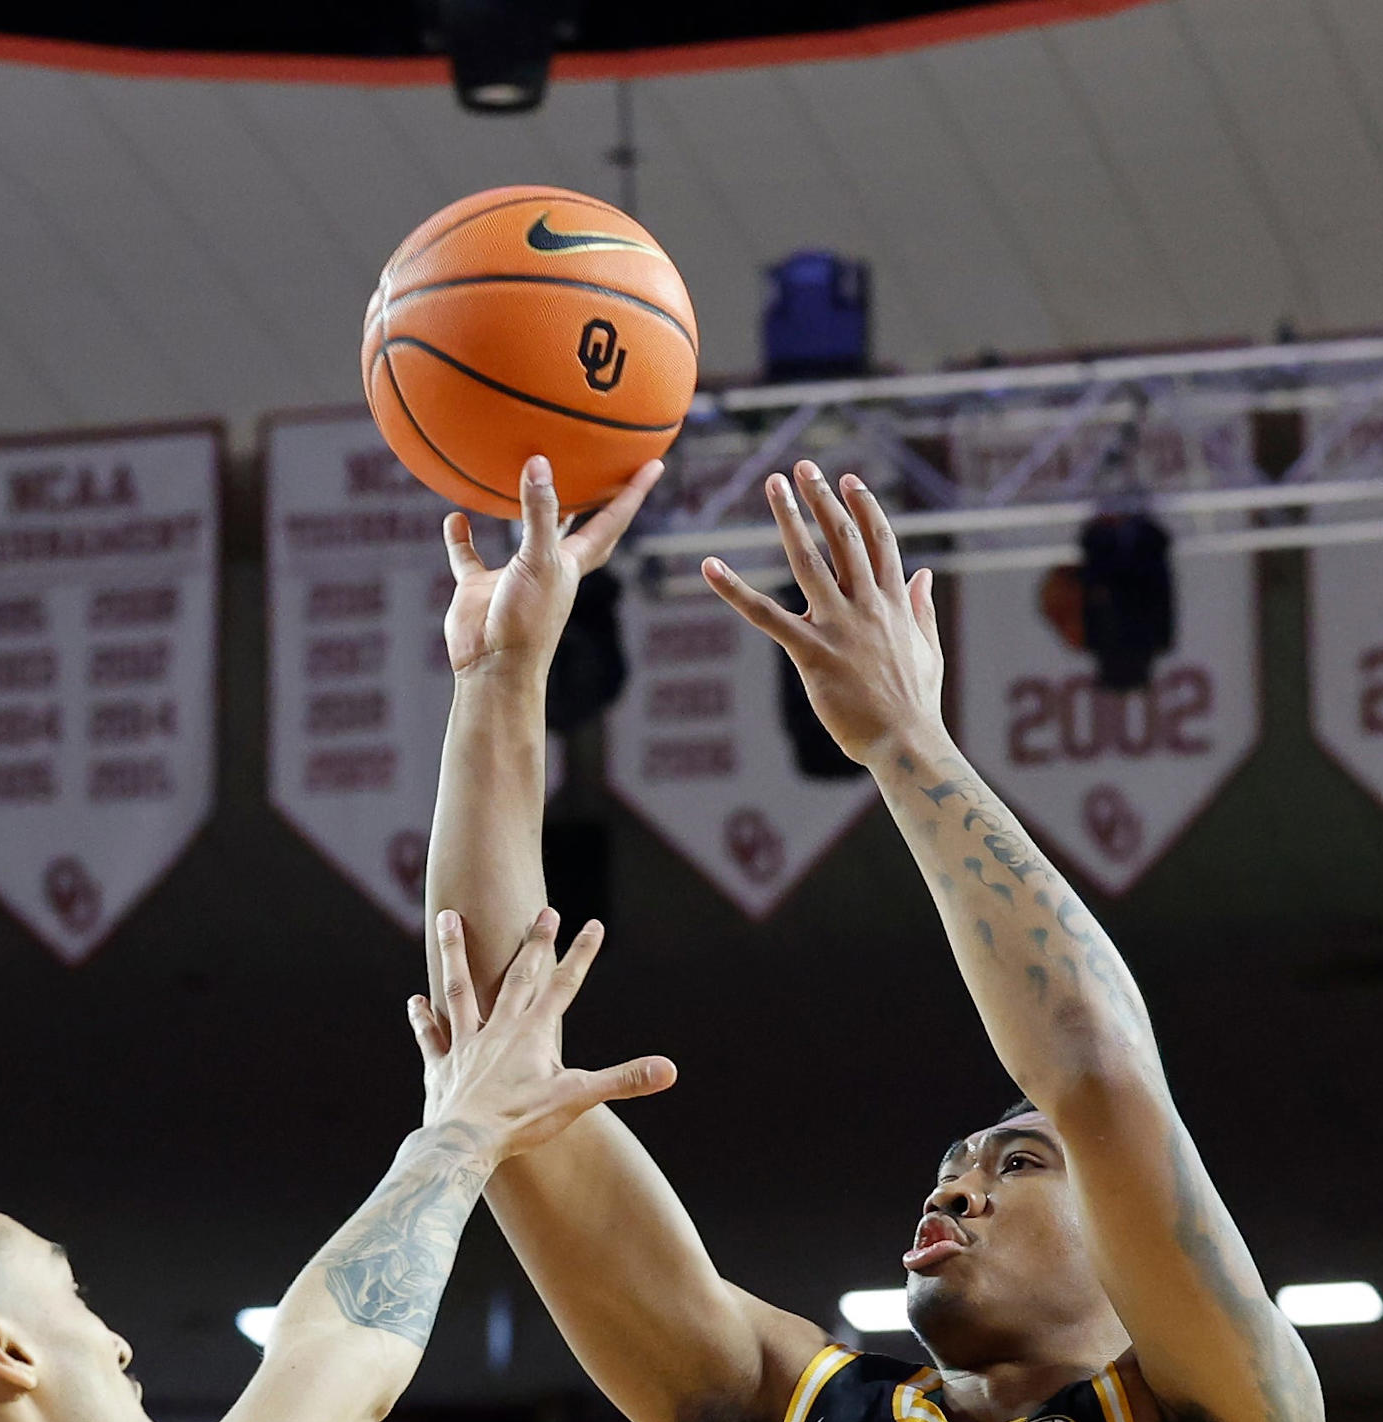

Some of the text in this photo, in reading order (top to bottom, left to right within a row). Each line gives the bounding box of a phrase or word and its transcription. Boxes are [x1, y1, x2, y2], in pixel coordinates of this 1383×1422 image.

[578, 318, 627, 392] OU
[9, 464, 137, 514] NCAA
[1008, 666, 1212, 766] 2002
